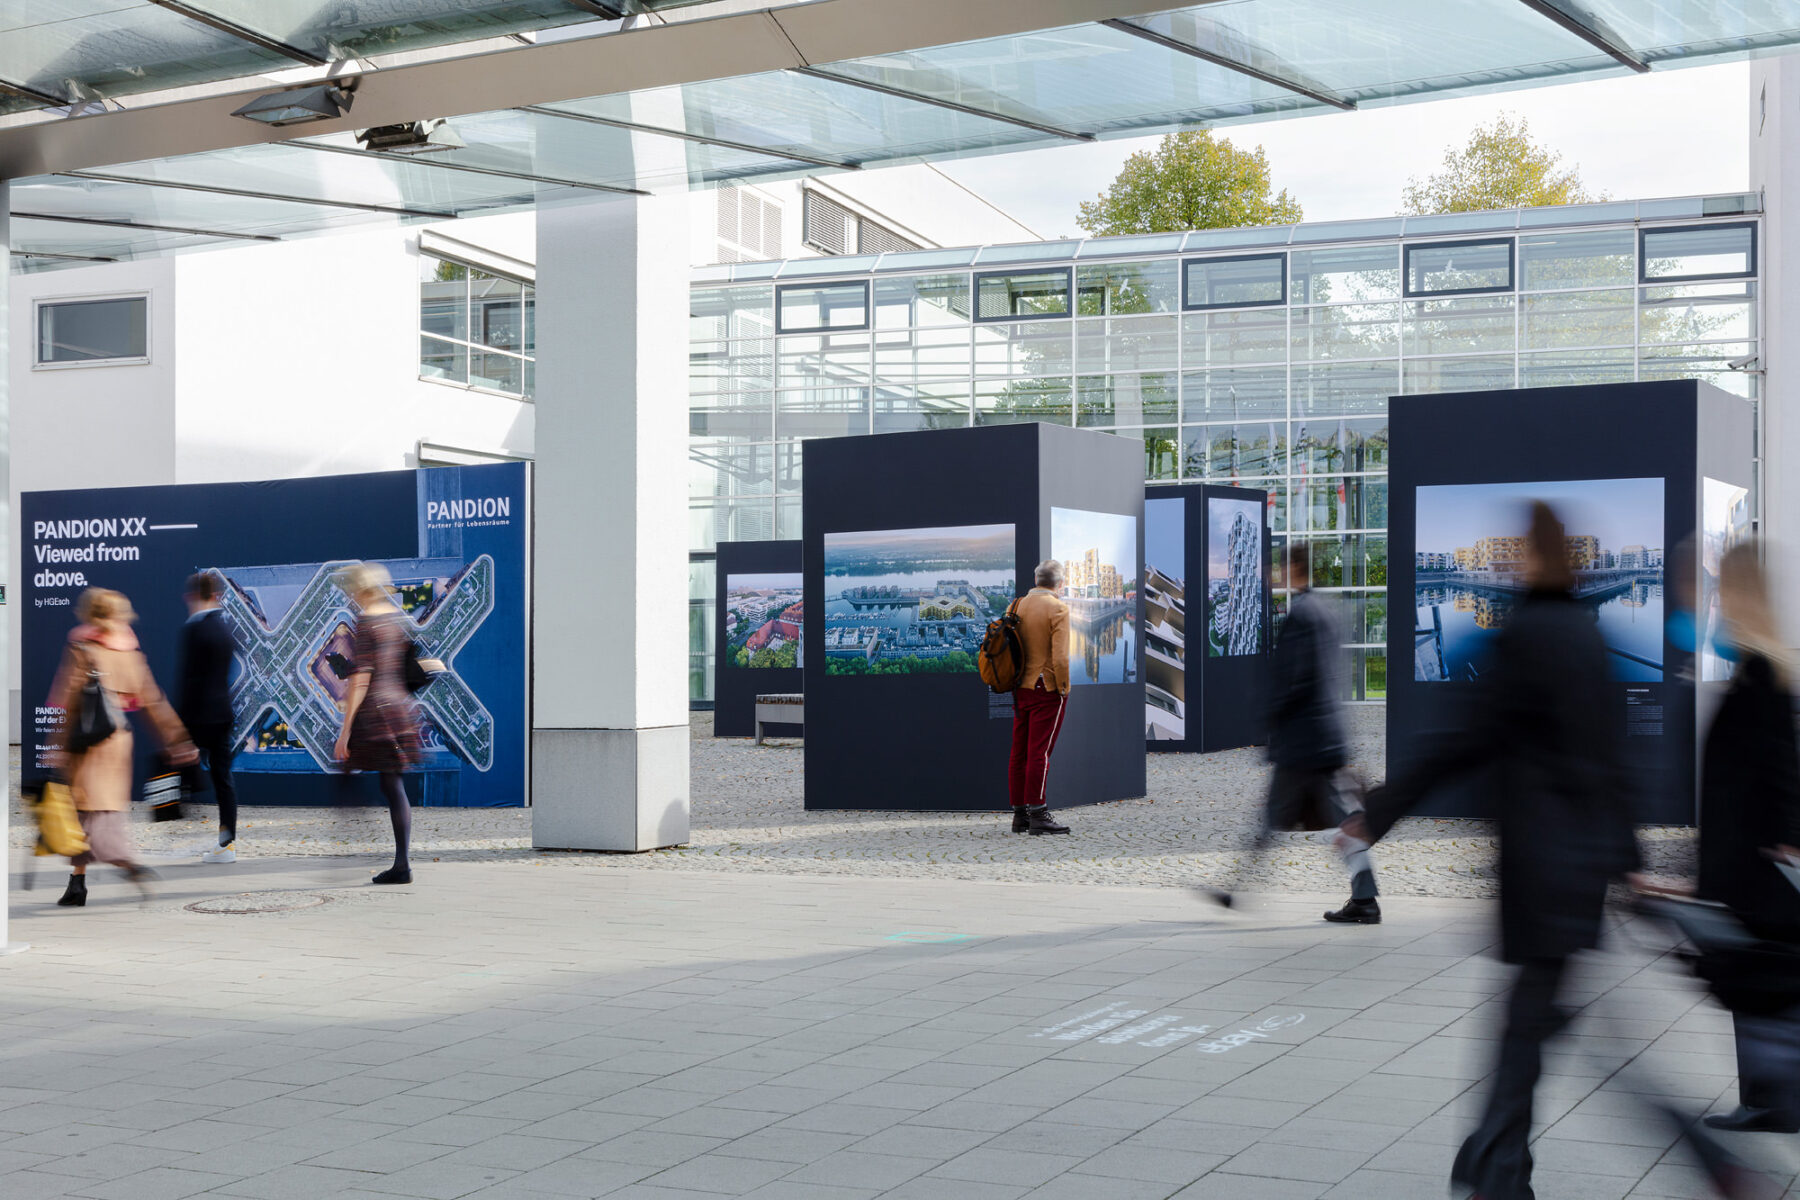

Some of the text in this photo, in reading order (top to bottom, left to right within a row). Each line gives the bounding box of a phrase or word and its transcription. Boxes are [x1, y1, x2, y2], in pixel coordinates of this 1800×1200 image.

[34, 517, 147, 540] PANDION XX
[34, 542, 140, 564] Viewed from
[34, 568, 88, 588] above.
[34, 598, 43, 608] by
[35, 716, 47, 724] auf
[47, 716, 58, 724] der
[1197, 1029, 1270, 1054] ebay
